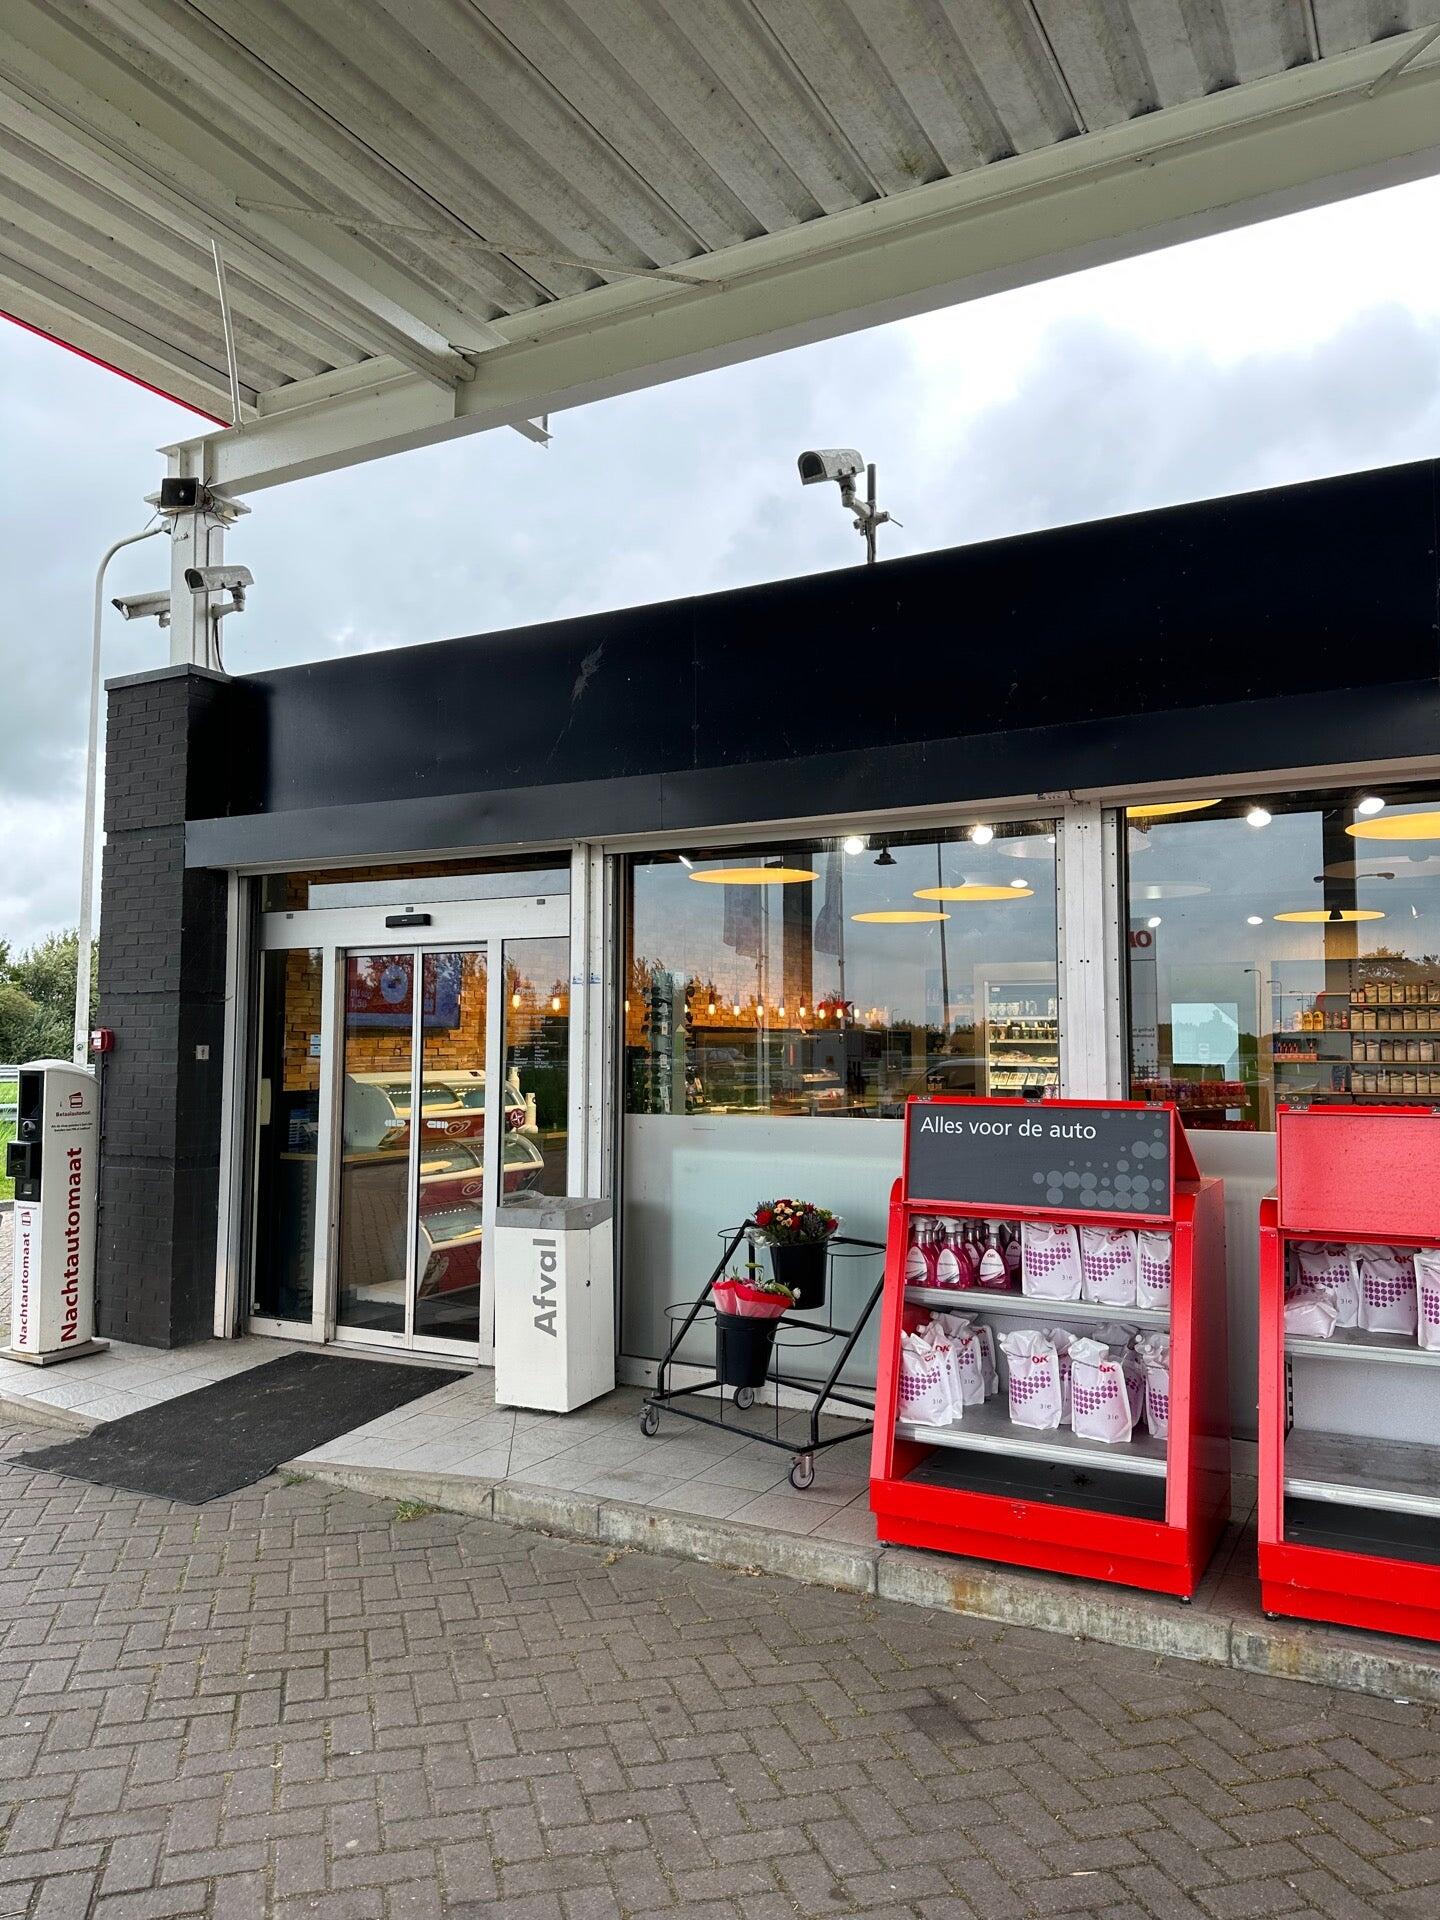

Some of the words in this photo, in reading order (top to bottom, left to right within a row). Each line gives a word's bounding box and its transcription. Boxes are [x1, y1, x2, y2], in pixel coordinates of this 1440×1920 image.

[920, 1116, 963, 1134] Alles
[968, 1121, 1012, 1136] voor
[1018, 1119, 1043, 1137] de
[1050, 1123, 1097, 1140] auto
[61, 1147, 81, 1342] Nachtautomaat
[19, 1232, 30, 1345] Nachtautomaat
[532, 1238, 557, 1338] Afval
[1032, 1355, 1049, 1364] OK
[1099, 1364, 1116, 1373] OK
